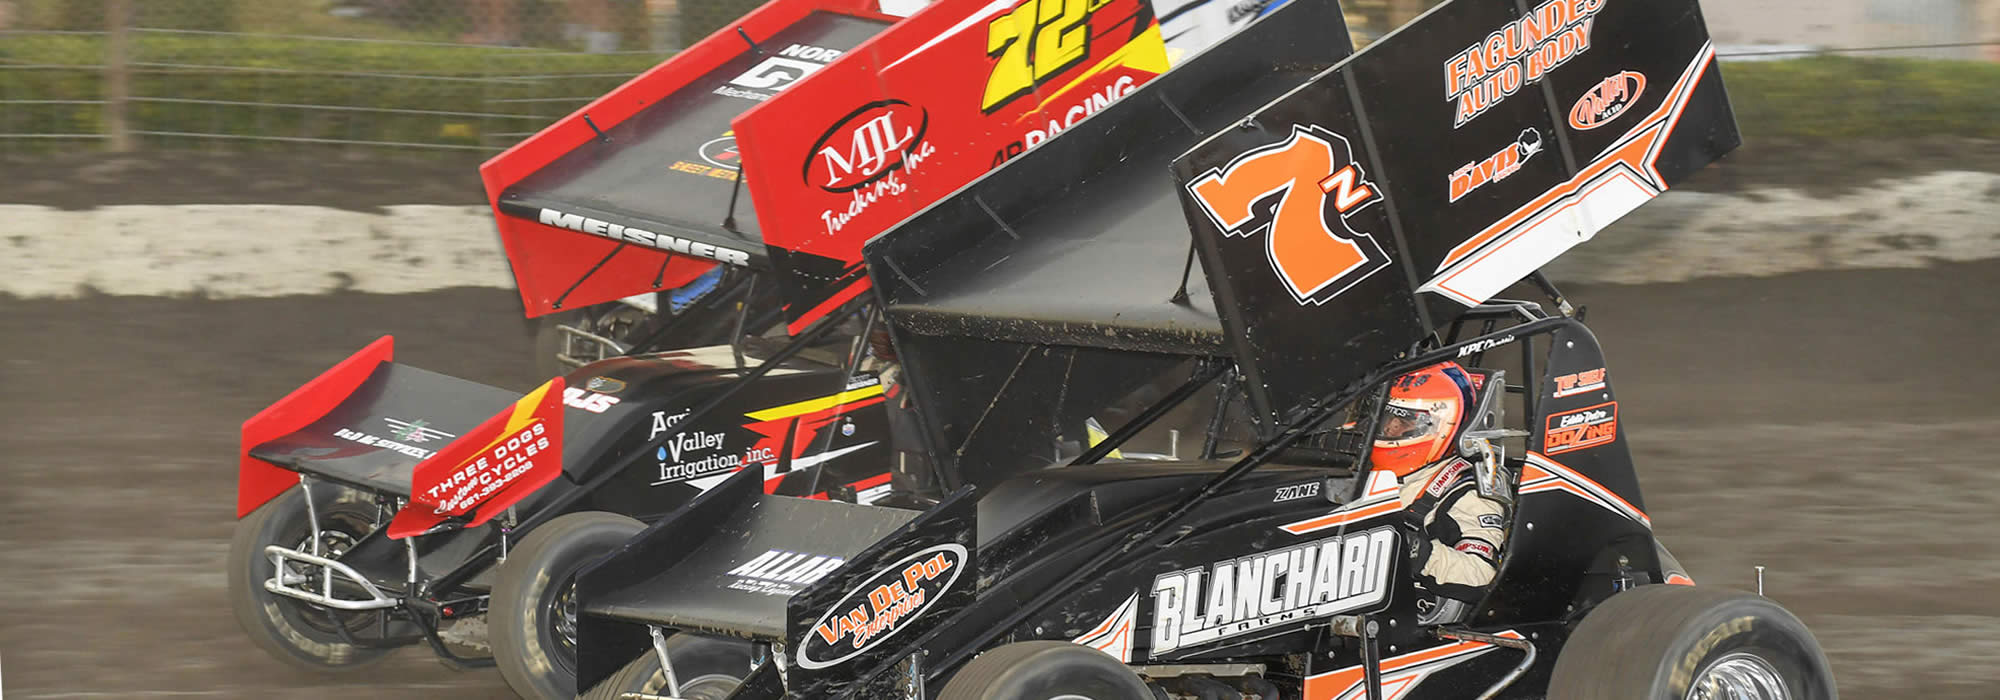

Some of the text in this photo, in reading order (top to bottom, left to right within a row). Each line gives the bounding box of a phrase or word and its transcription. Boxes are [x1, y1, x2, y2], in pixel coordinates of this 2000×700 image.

[981, 0, 1113, 115] 72
[1454, 15, 1595, 129] AUTO BODY
[1025, 75, 1136, 150] RACING
[1602, 103, 1623, 119] ACID
[818, 111, 914, 187] MJL
[1449, 142, 1520, 203] DAVIS
[539, 207, 750, 266] MEISNER
[428, 423, 545, 498] THREE DOGS
[479, 437, 550, 485] CYCLES
[668, 431, 725, 463] Valley
[746, 447, 775, 463] inc.
[1432, 461, 1464, 493] SIMPSON
[1273, 481, 1320, 502] ZANE
[816, 604, 869, 646] VAN
[902, 552, 953, 593] POL
[852, 587, 926, 649] Enterprises
[1151, 526, 1397, 656] BLANCHARD
[1218, 606, 1316, 636] FARMS
